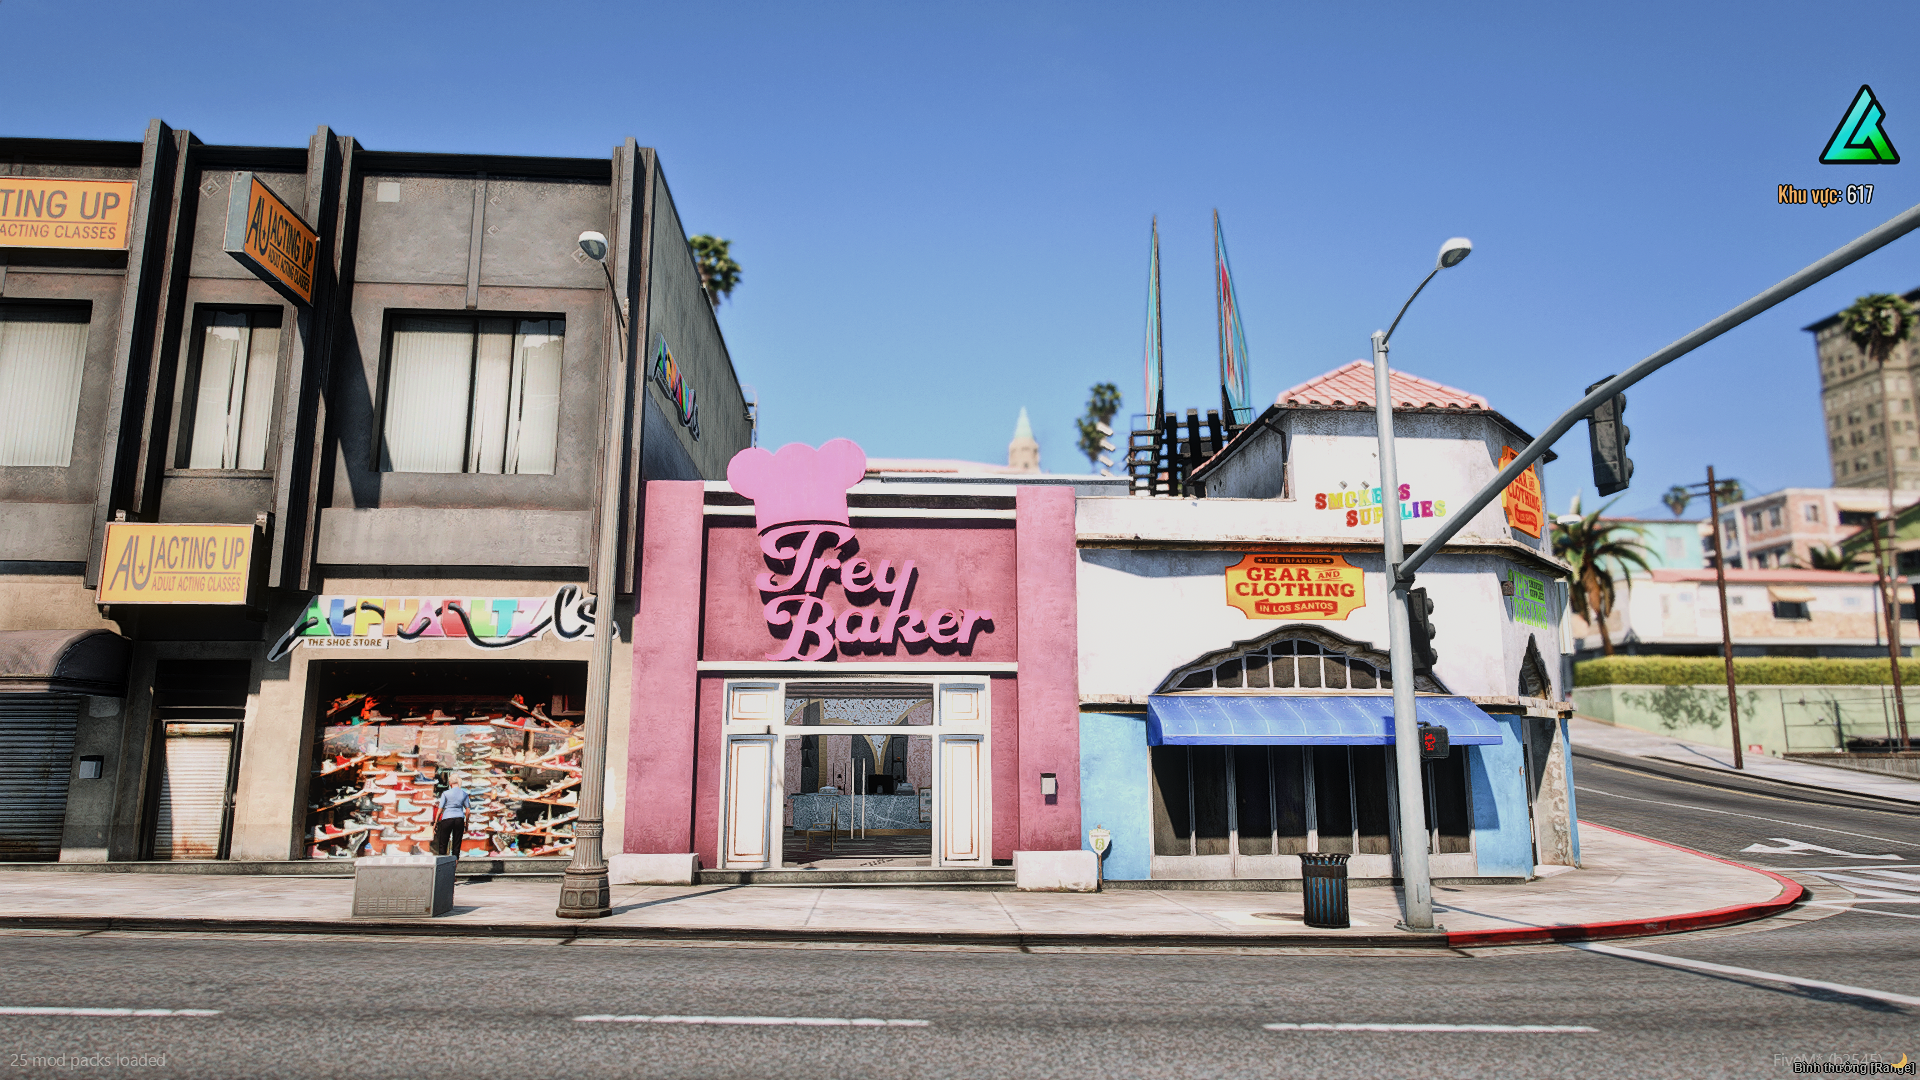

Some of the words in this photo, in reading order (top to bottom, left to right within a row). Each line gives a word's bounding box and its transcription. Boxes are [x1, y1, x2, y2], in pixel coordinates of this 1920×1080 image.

[80, 191, 120, 220] UP
[54, 225, 117, 240] CLASSES
[270, 210, 301, 263] ACTING
[301, 236, 314, 271] UP
[1314, 483, 1411, 511] SMOKES
[1345, 499, 1447, 528] SUPLIES
[154, 535, 217, 570] ACTING
[222, 537, 245, 570] UP
[756, 523, 916, 605] Trey
[151, 575, 177, 591] ADULT
[177, 576, 206, 592] ACTING
[206, 576, 241, 593] CLASSES
[1246, 567, 1312, 582] GEAR
[1318, 570, 1340, 579] AND
[1235, 582, 1356, 598] CLOTHING
[1273, 603, 1292, 613] LOS
[1294, 602, 1334, 611] SANTOS
[1514, 596, 1548, 630] DREAMS
[763, 594, 992, 661] Baker
[308, 638, 325, 646] THE
[326, 638, 352, 647] SHOE
[353, 638, 383, 647] STORE
